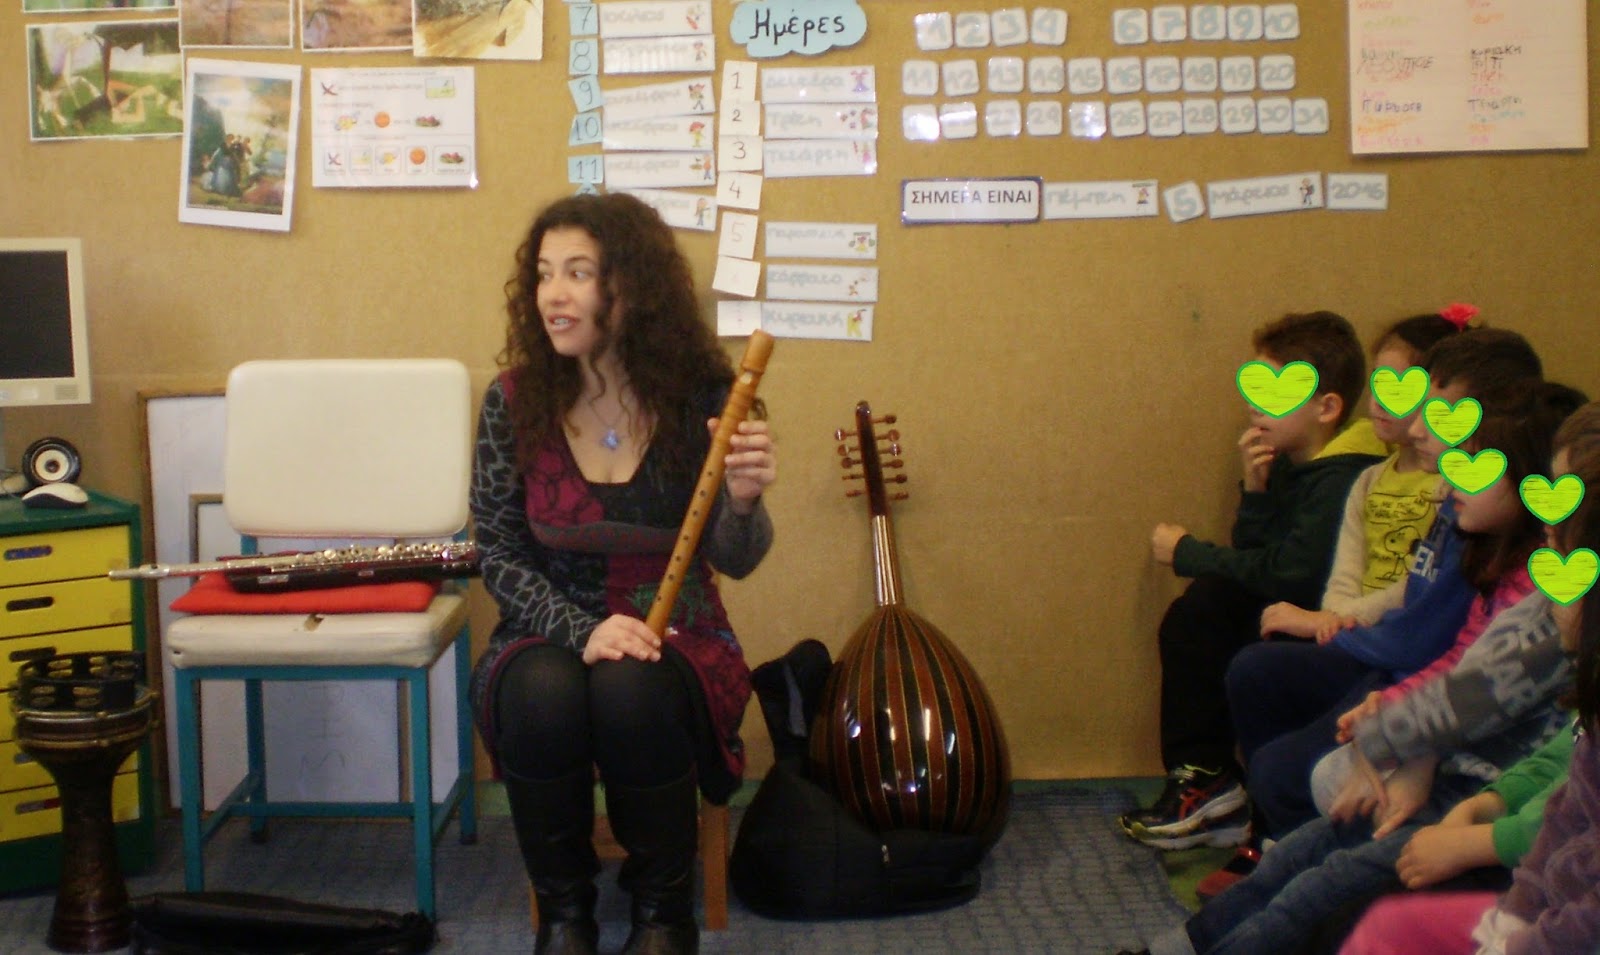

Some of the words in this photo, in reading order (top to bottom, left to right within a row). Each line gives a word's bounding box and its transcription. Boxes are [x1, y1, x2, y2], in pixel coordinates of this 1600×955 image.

[574, 5, 593, 31] 7
[749, 8, 846, 47] Ημέρες
[957, 14, 985, 44] 2
[998, 13, 1021, 41] 3
[1036, 9, 1058, 42] 4
[1117, 9, 1144, 42] 6
[1158, 10, 1185, 39] 7
[1197, 5, 1219, 37] 8
[1234, 7, 1254, 39] 9
[1265, 12, 1298, 34] 10
[572, 40, 592, 72] 8
[731, 71, 742, 90] 1
[906, 67, 935, 87] 11
[946, 69, 978, 91] 12
[990, 64, 1021, 86] 13
[1071, 66, 1103, 89] 15
[1112, 64, 1141, 87] 16
[1150, 64, 1177, 85] 17
[1187, 62, 1215, 86] 18
[1224, 63, 1253, 88] 19
[1262, 63, 1294, 83] 20
[579, 80, 593, 106] 9
[732, 108, 743, 123] 2
[1112, 107, 1140, 128] 26
[1151, 111, 1179, 129] 27
[1186, 106, 1217, 124] 28
[1224, 104, 1254, 125] 29
[1261, 105, 1291, 124] 30
[1296, 106, 1327, 125] 31
[574, 116, 600, 142] 10
[732, 140, 747, 160] 3
[575, 159, 599, 180] 11
[728, 180, 743, 200] 4
[911, 188, 982, 206] ΣΗΜΕΡΑ
[987, 188, 1033, 205] ΕΙΝΑΙ
[1173, 186, 1198, 217] 5
[1332, 182, 1386, 201] 2016
[731, 220, 745, 243] 5
